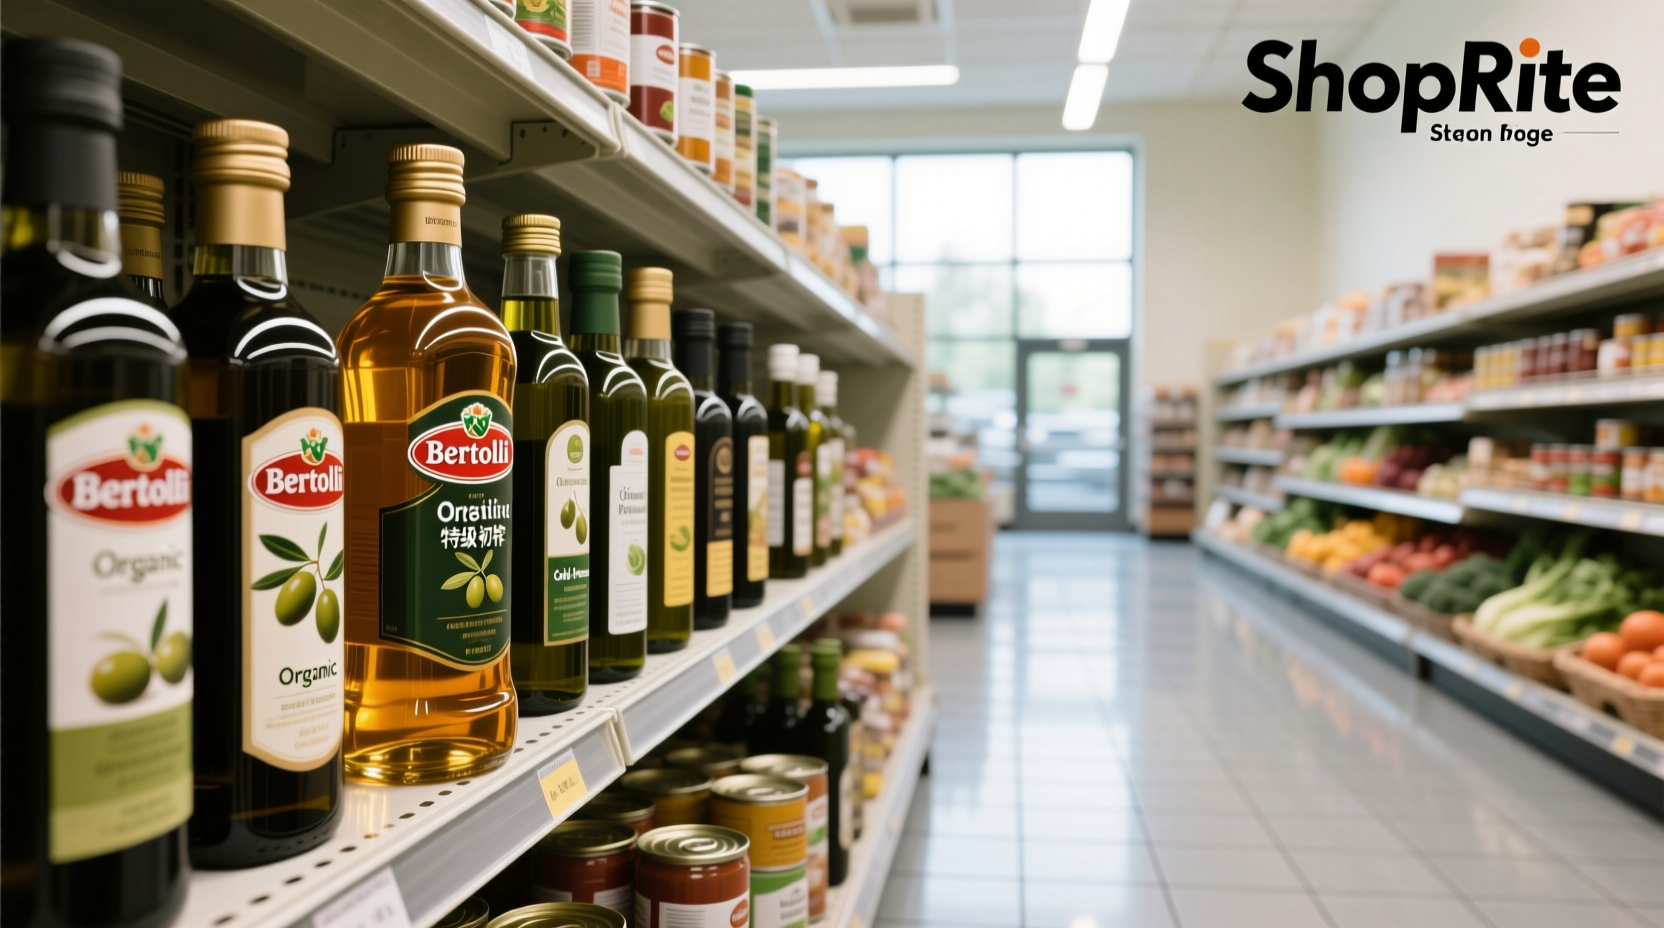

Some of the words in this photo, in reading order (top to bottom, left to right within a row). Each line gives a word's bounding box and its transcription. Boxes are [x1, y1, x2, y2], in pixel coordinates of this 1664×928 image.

[425, 439, 509, 465] Bertolli
[72, 468, 189, 511] Bertolli
[265, 465, 343, 495] Bertolli
